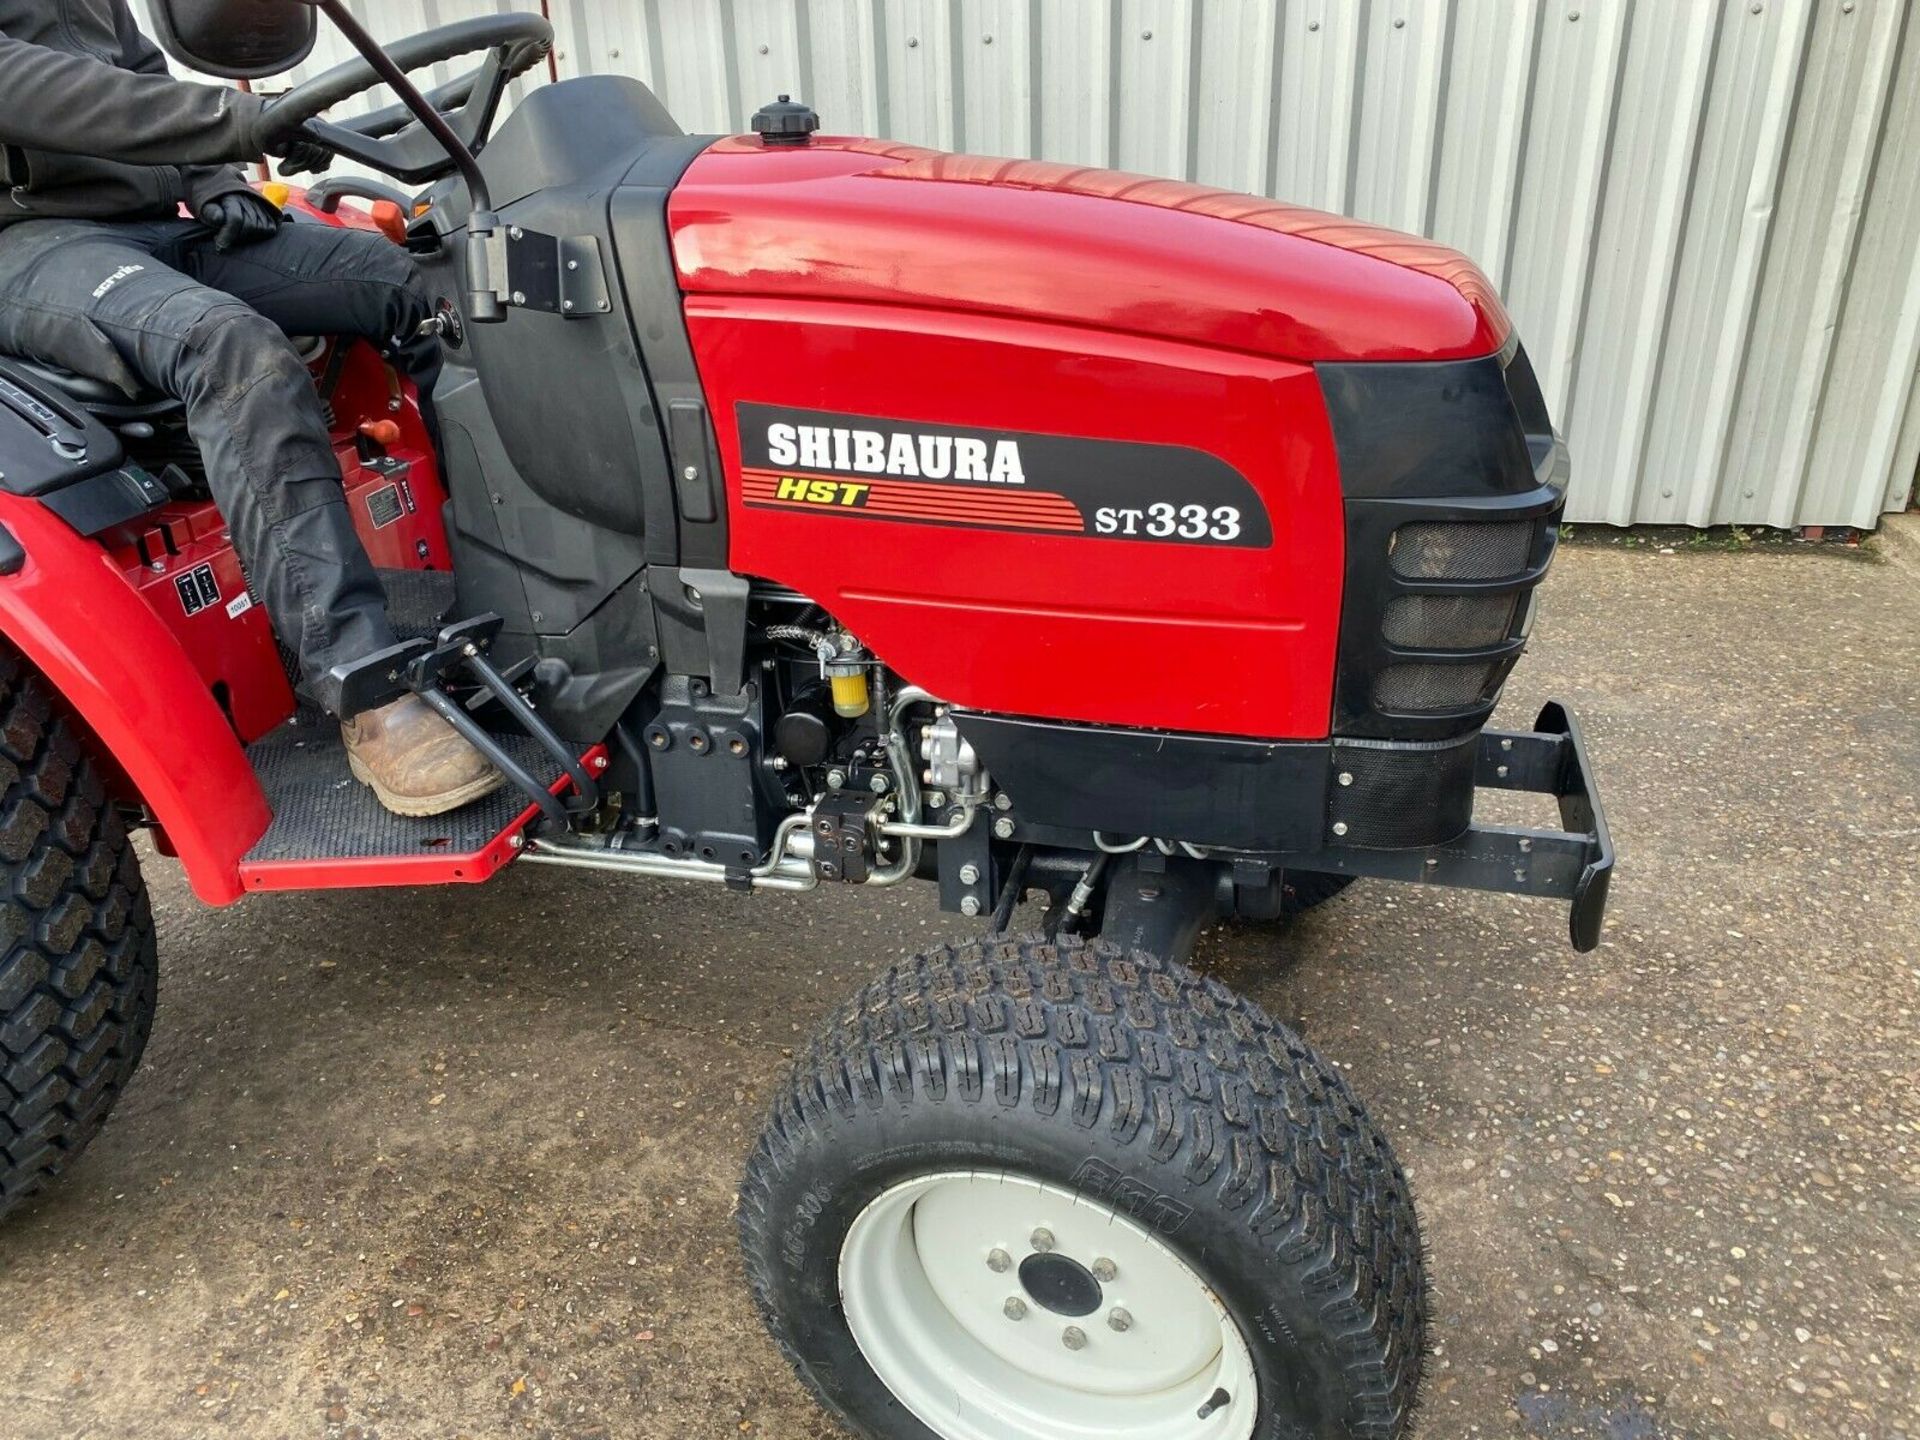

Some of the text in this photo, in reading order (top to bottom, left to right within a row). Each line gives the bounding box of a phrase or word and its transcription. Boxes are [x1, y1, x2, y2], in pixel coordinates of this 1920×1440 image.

[767, 422, 1026, 485] SHIBAURA
[776, 477, 869, 507] HST
[1095, 502, 1241, 541] ST333
